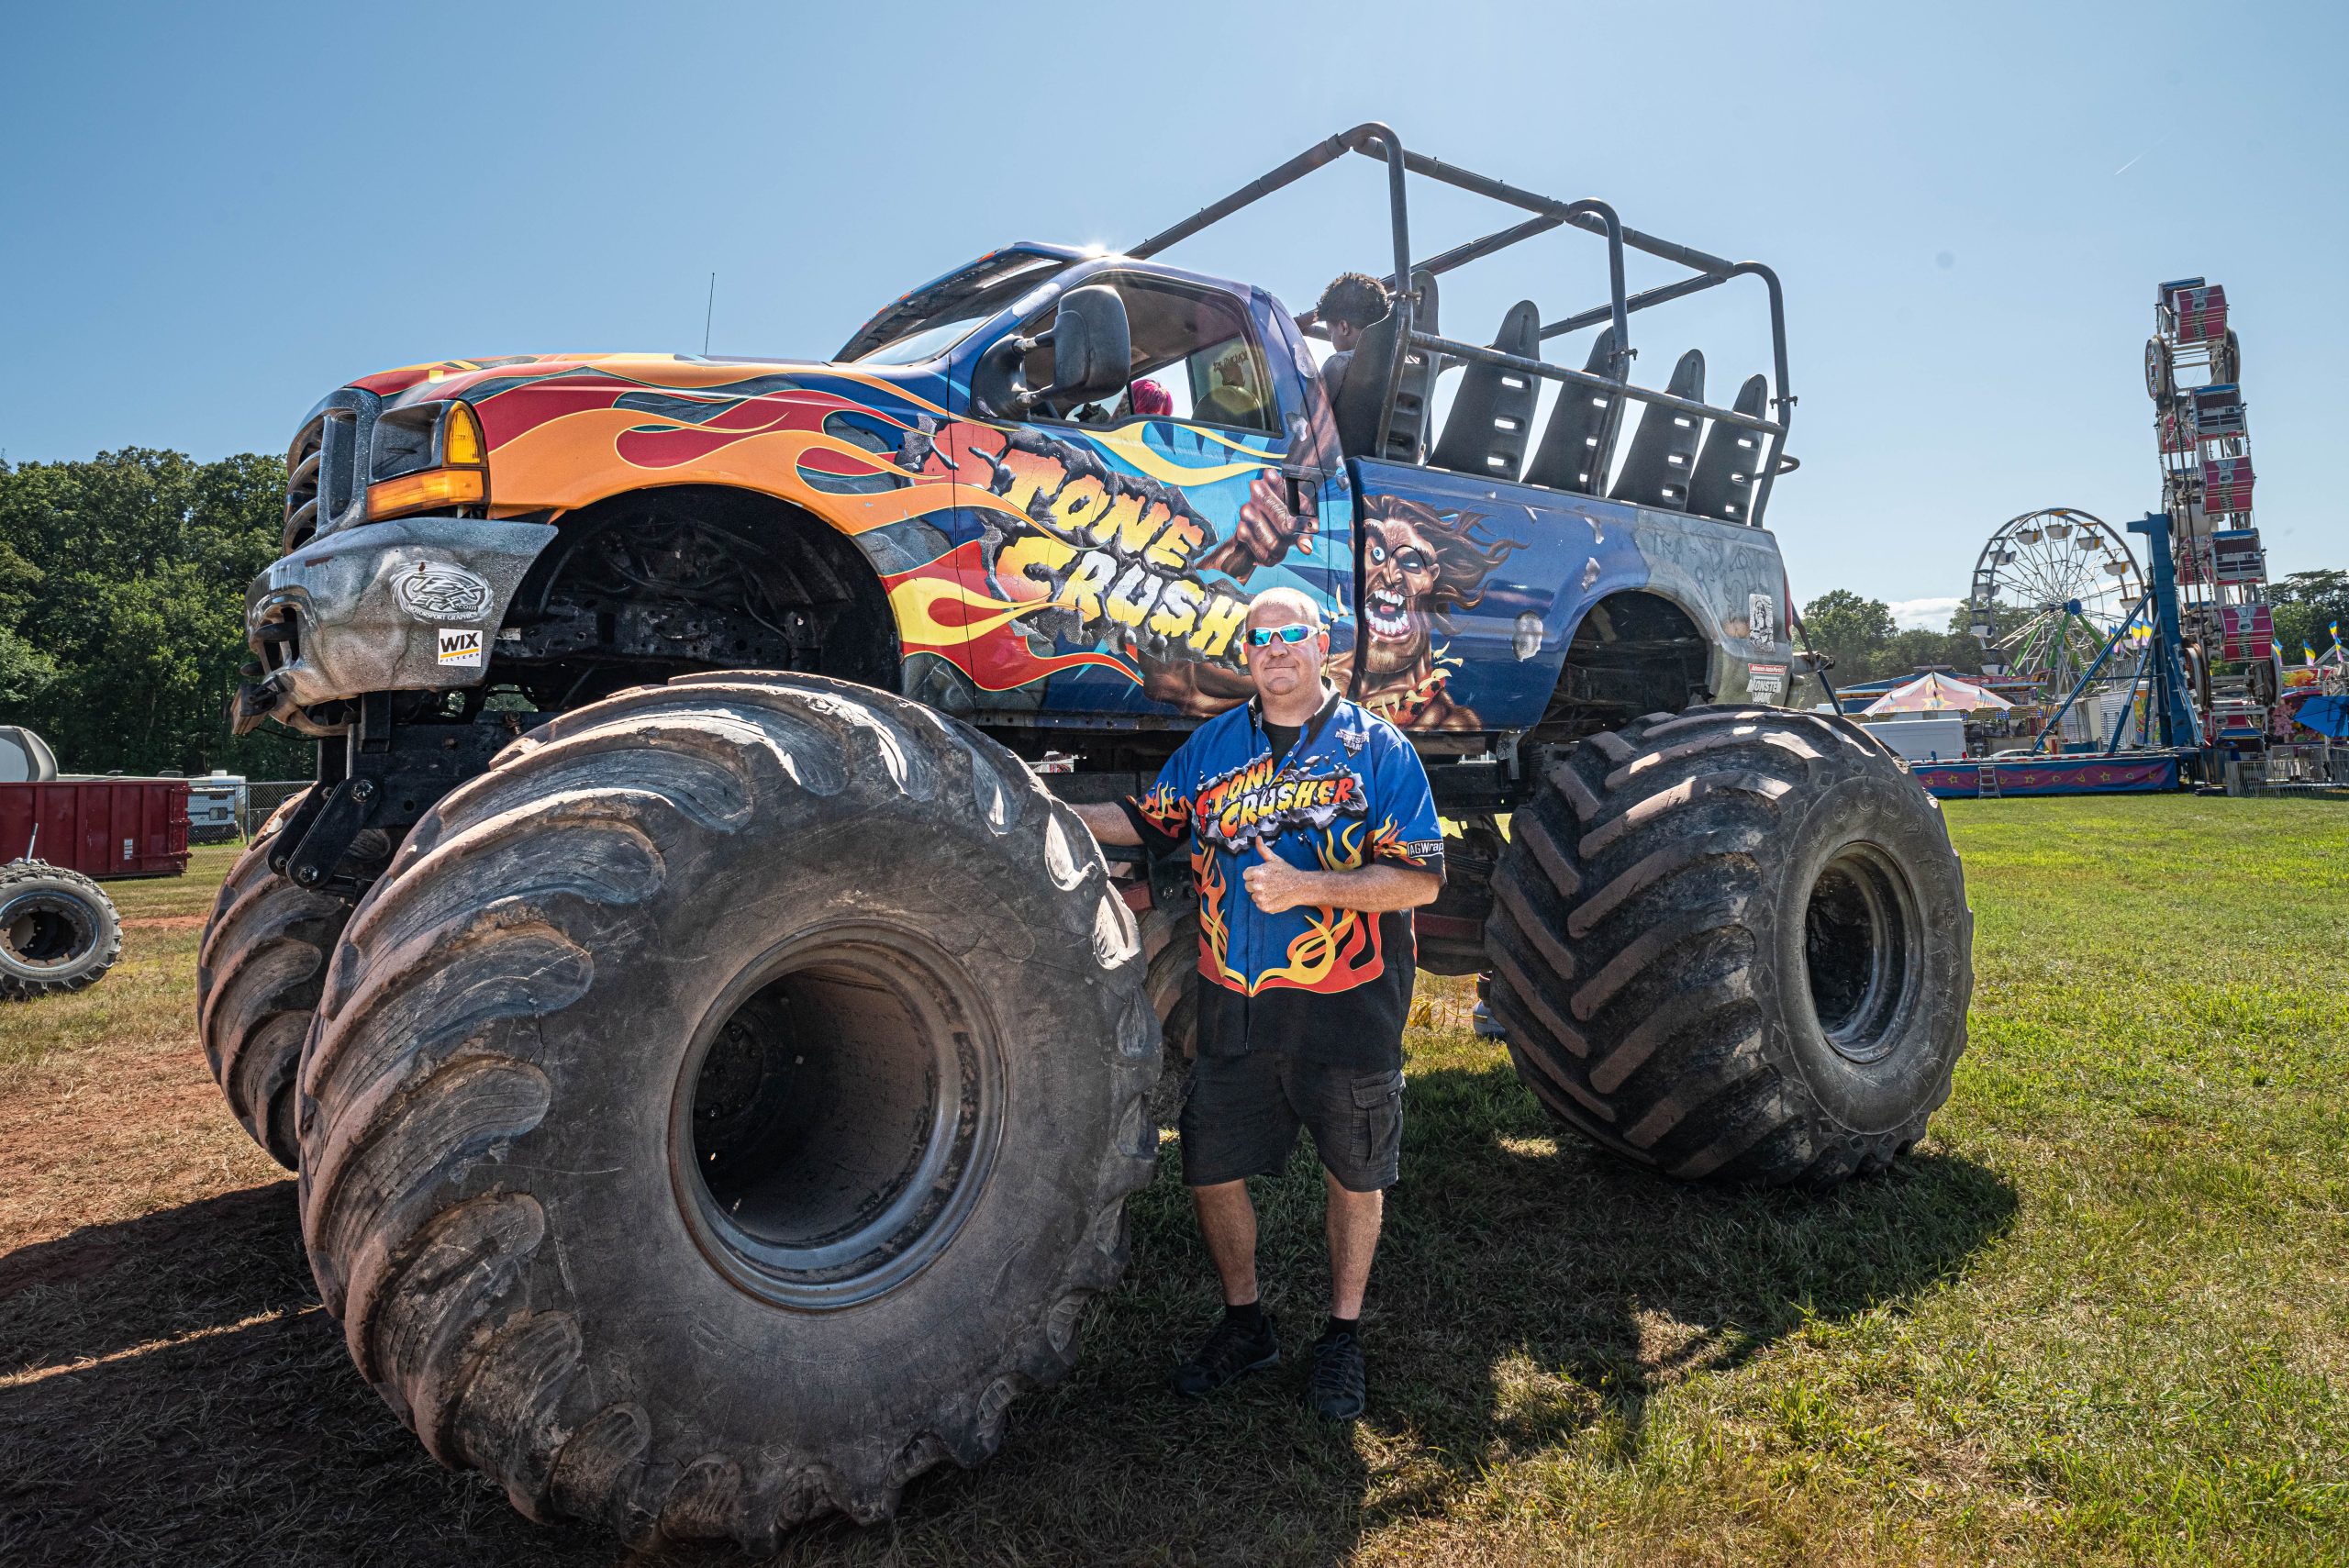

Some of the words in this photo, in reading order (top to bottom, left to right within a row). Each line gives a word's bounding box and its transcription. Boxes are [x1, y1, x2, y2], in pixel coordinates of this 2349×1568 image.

[996, 536, 1248, 666] CRUSH
[407, 604, 446, 620] MOTORSPORT
[447, 611, 478, 621] GRAPHICS
[440, 631, 480, 652] WIX
[440, 652, 480, 663] FILTERS
[1219, 776, 1354, 838] CRUSHER
